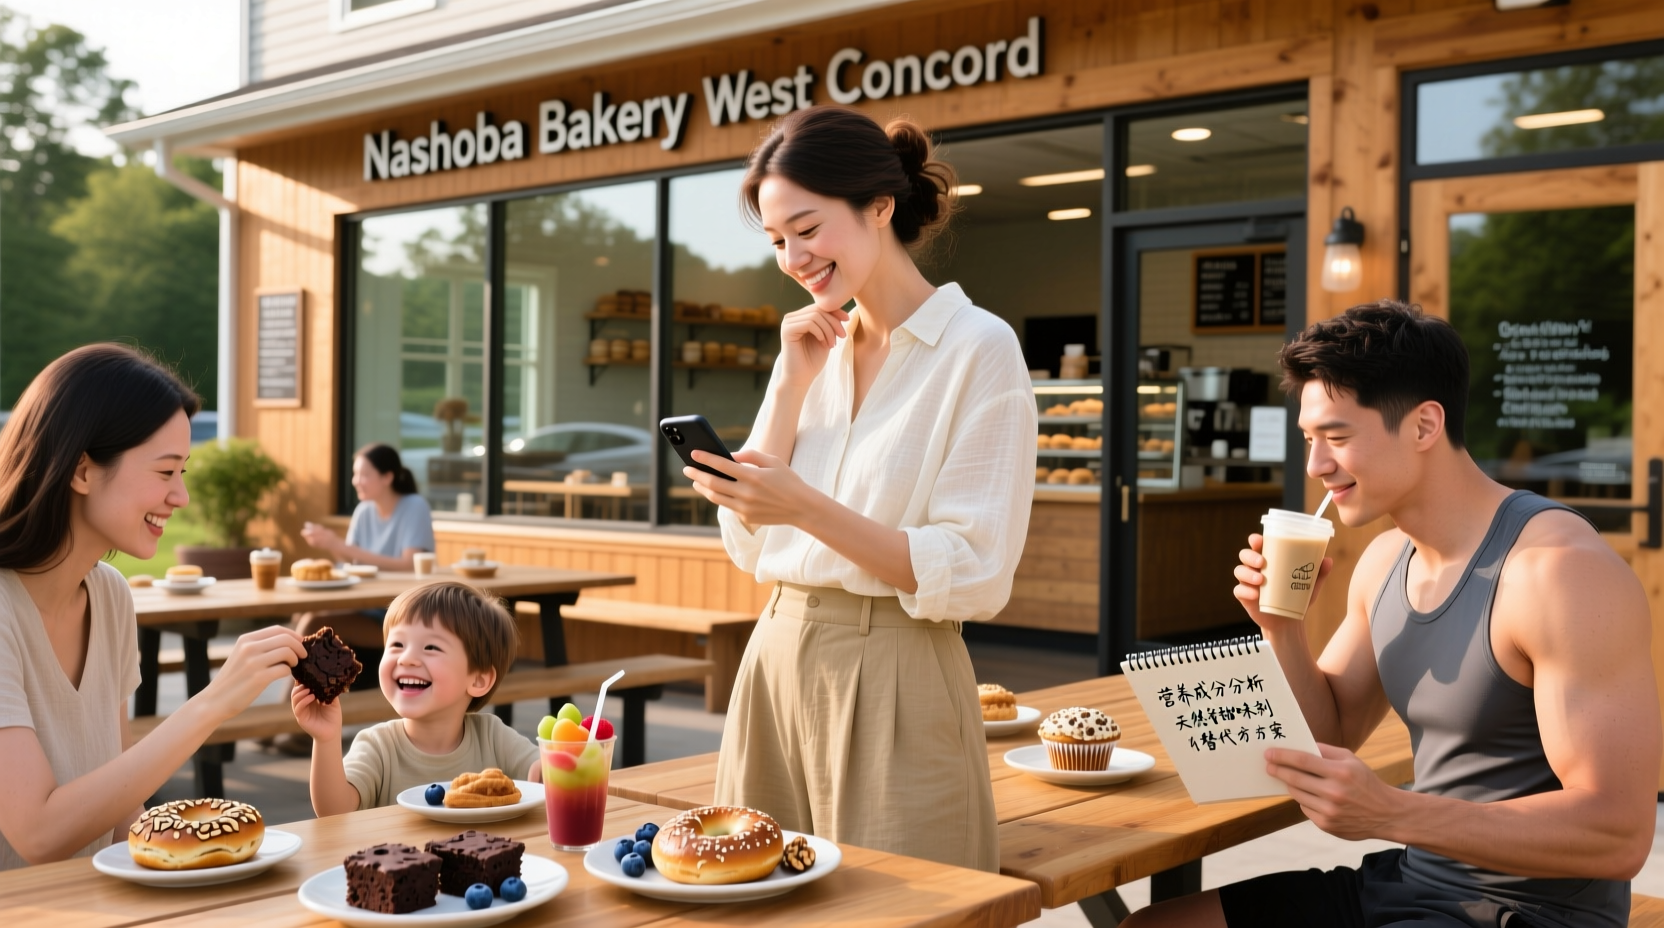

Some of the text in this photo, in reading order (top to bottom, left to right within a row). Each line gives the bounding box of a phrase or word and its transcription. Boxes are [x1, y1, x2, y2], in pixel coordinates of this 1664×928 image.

[363, 16, 1040, 181] Nashoba Bakery West Concord
[1157, 674, 1264, 708] 营养成分分析
